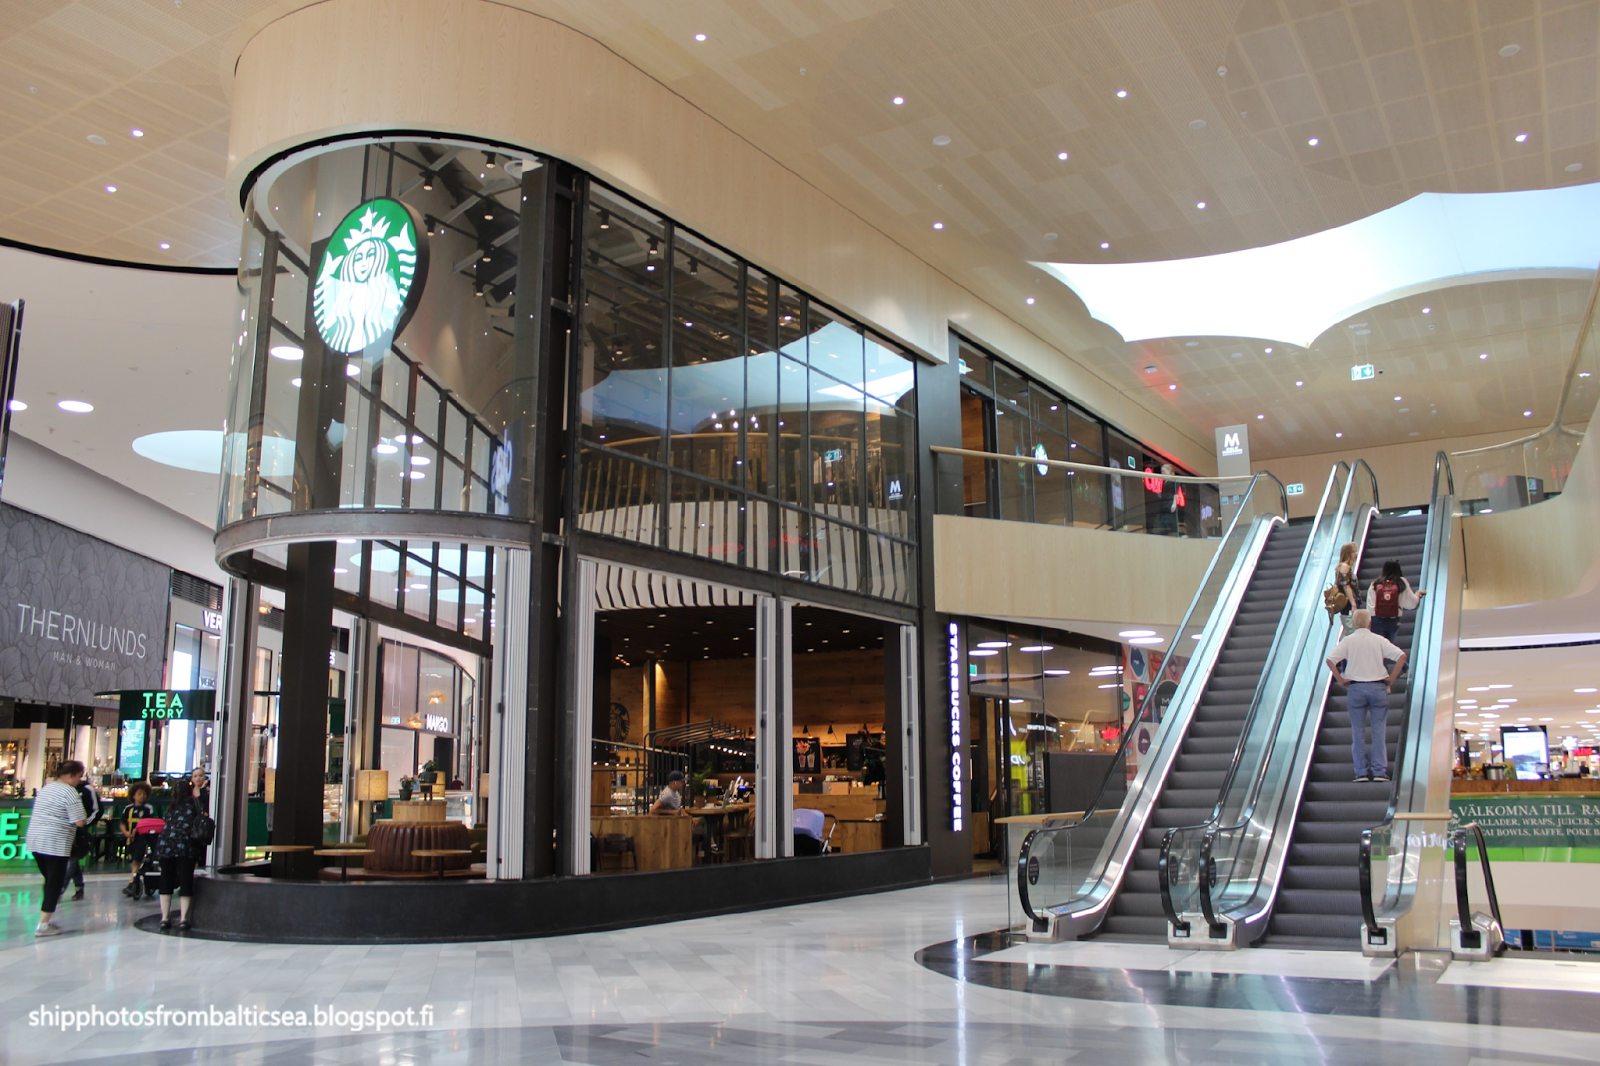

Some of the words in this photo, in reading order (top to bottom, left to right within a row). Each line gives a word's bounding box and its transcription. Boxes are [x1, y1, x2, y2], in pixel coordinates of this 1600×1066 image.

[18, 603, 147, 659] THERNLUNDS
[53, 651, 72, 664] MAN
[76, 656, 82, 666] &
[85, 656, 117, 671] WOMAN
[949, 622, 961, 747] STARBUCKS
[143, 692, 184, 708] TEA
[141, 708, 184, 719] STORY
[426, 713, 448, 733] MANGO
[952, 751, 962, 832] COFFEE
[1458, 803, 1538, 817] VÄLKOMNA
[1540, 804, 1576, 816] TILL
[1566, 828, 1591, 837] POKE
